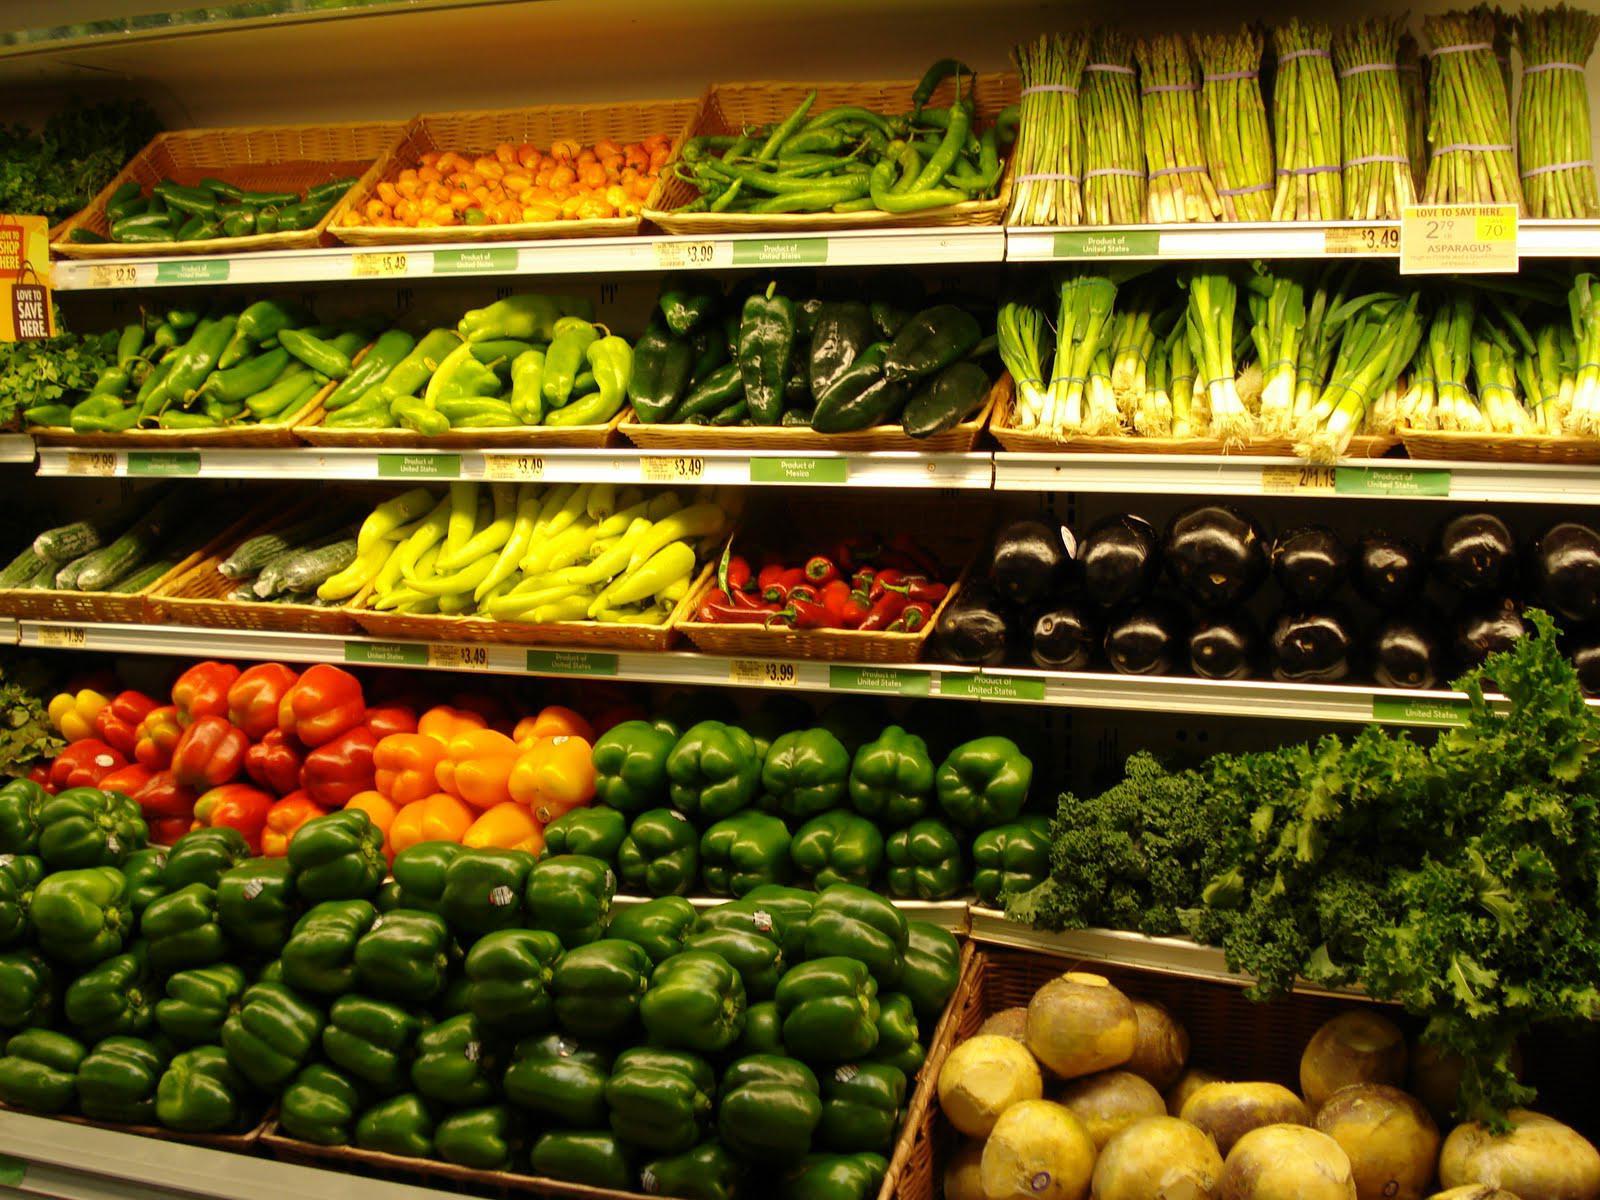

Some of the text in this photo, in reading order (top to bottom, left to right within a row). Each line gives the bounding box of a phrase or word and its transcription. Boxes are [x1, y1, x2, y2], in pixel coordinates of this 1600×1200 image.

[1416, 208, 1438, 218] LOVE
[1441, 208, 1453, 217] TO
[1455, 208, 1477, 216] SAVE
[1088, 237, 1126, 245] Product of
[1362, 230, 1399, 249] $3.49
[0, 240, 20, 255] SHOP
[1083, 245, 1130, 253] United States
[1427, 243, 1492, 253] ASPARAGUS
[687, 244, 714, 263] $3.99
[16, 289, 42, 301] LOVE TO
[17, 301, 44, 319] SAVE
[19, 319, 48, 337] HERE.
[675, 458, 702, 476] $3.49
[781, 461, 816, 470] Product of
[785, 469, 810, 478] Mexico
[1373, 472, 1414, 481] Product of
[1367, 480, 1419, 490] United States
[460, 647, 486, 665] $3.49
[765, 663, 794, 681] $3.99
[880, 679, 902, 687] States
[974, 675, 1012, 686] Product of
[967, 684, 1017, 696] United States
[1405, 708, 1458, 719] United States
